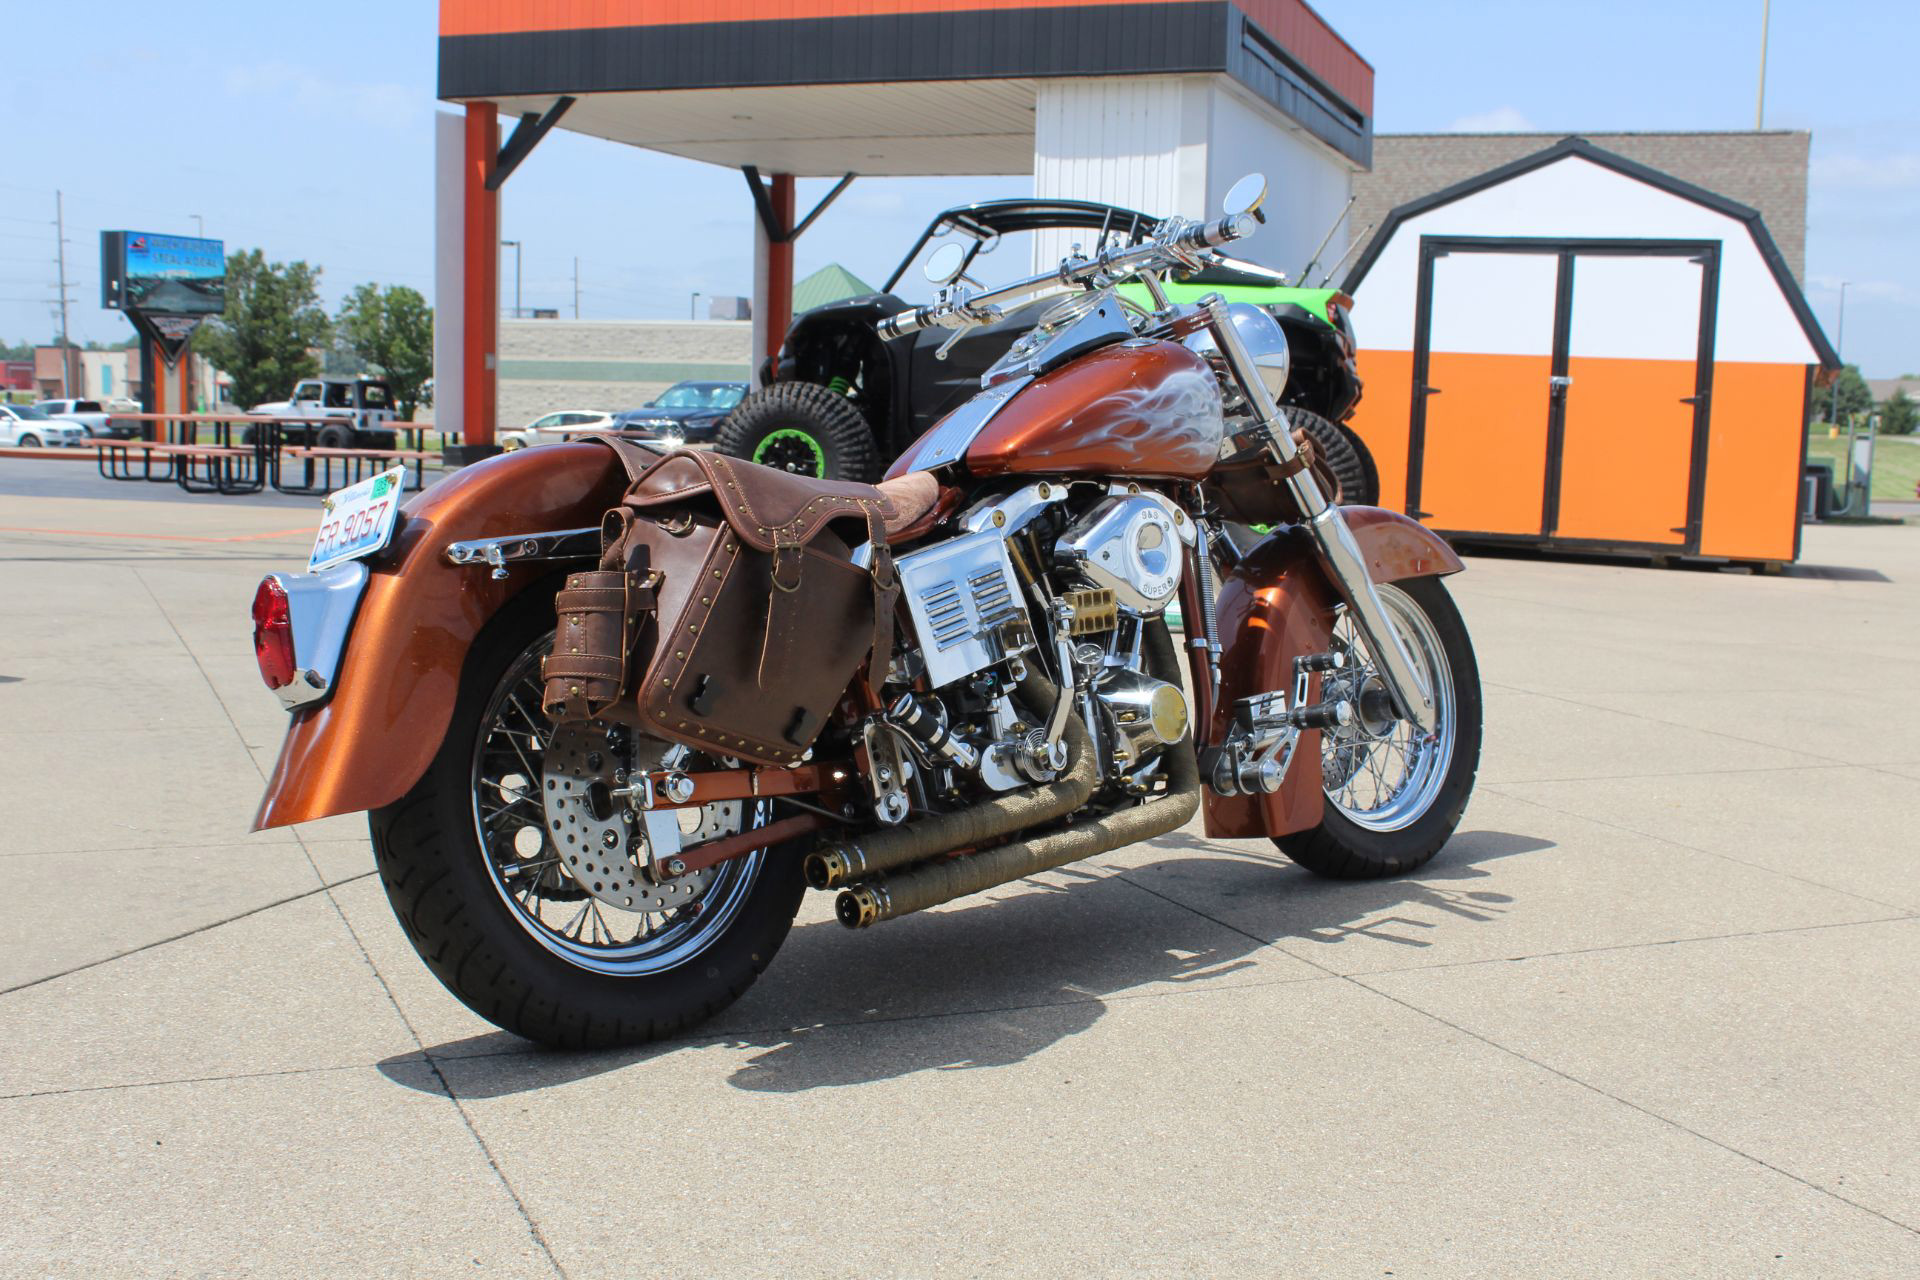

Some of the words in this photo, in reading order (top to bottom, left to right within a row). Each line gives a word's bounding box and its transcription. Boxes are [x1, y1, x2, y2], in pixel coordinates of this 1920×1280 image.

[1142, 512, 1159, 520] S&S
[340, 500, 389, 545] 9057
[1142, 584, 1168, 596] SUPER
